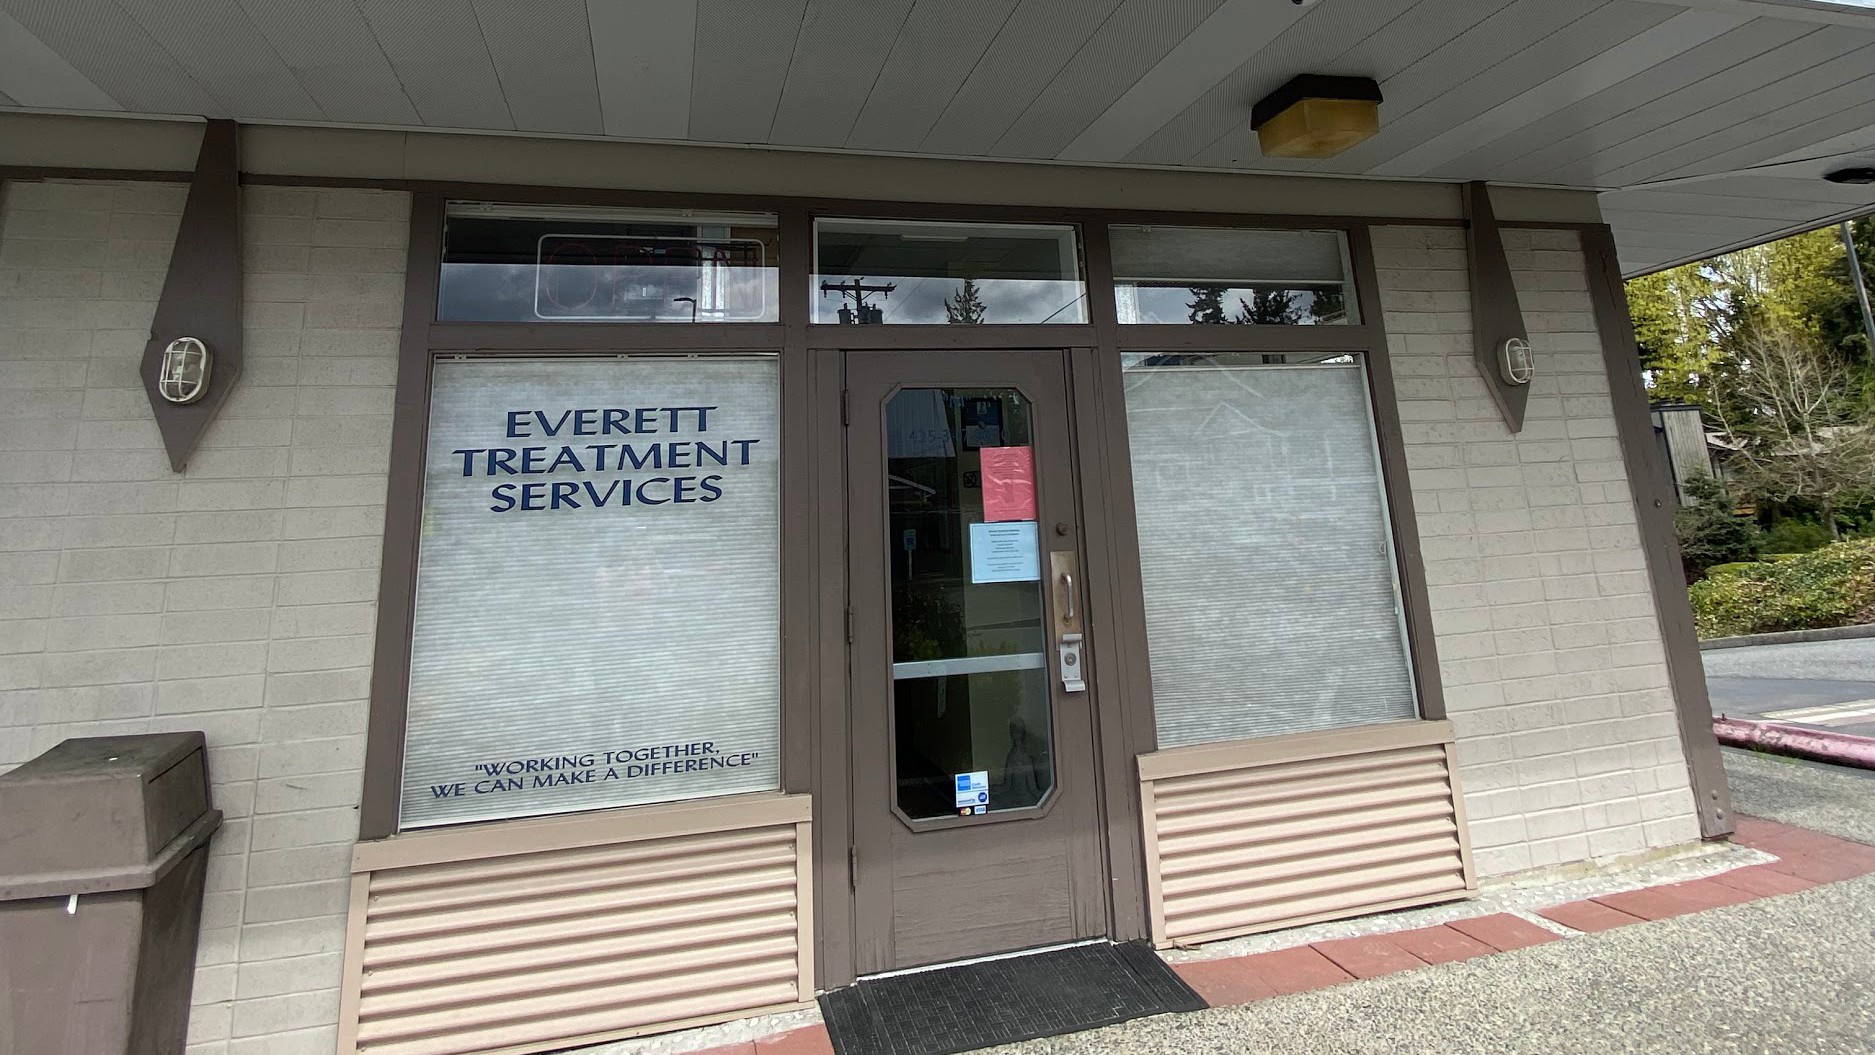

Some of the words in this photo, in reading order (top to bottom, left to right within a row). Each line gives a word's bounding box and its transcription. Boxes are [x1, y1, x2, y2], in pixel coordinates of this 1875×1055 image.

[506, 406, 718, 438] EVERETT
[452, 439, 760, 477] TREATMENT
[490, 475, 723, 513] SERVICES
[430, 782, 466, 799] WE
[474, 776, 524, 794] CAN
[532, 769, 597, 787] MAKE
[604, 767, 619, 781] A
[627, 752, 759, 778] DIFFERENCE"
[474, 753, 595, 777] "WORKING
[603, 741, 720, 765] TOGETHER,
